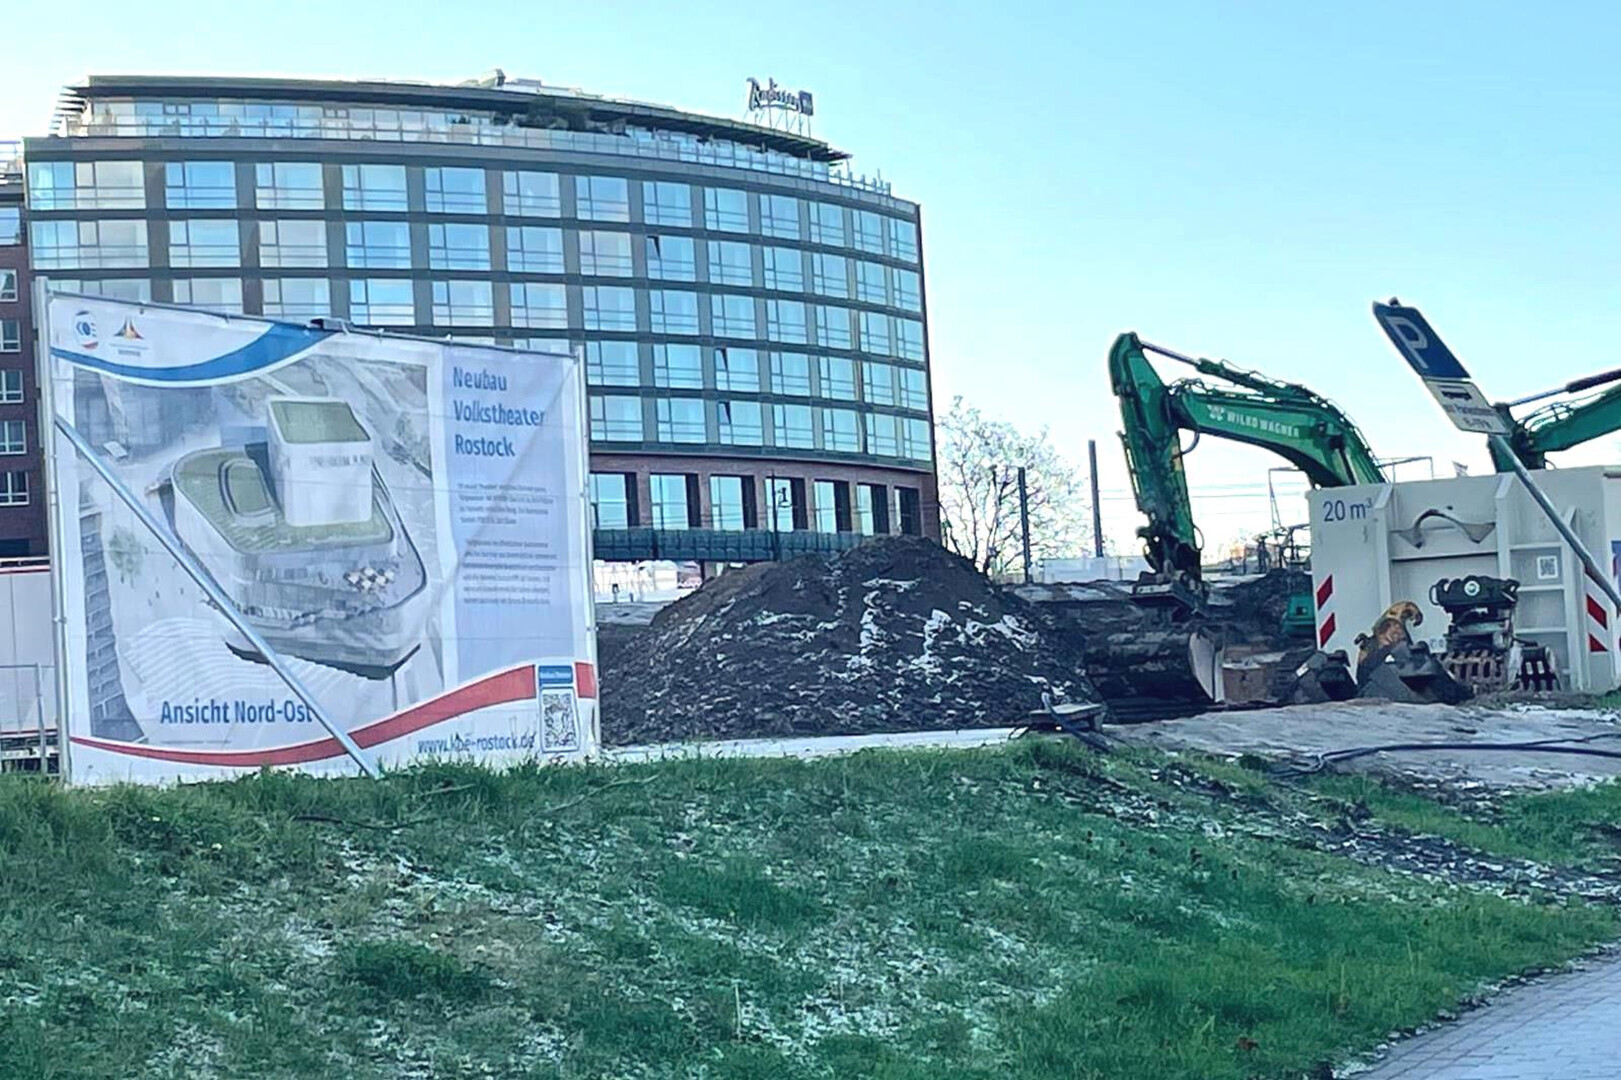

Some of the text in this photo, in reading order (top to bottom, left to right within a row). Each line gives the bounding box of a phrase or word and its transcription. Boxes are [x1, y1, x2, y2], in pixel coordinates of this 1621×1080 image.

[1382, 315, 1429, 369] P
[452, 366, 508, 392] Neubau
[453, 399, 546, 427] Volkstheater
[1259, 419, 1300, 438] WAGNER
[454, 434, 517, 458] Rostock
[1323, 499, 1346, 522] 20
[160, 697, 314, 725] Ansicht Nord-Ost
